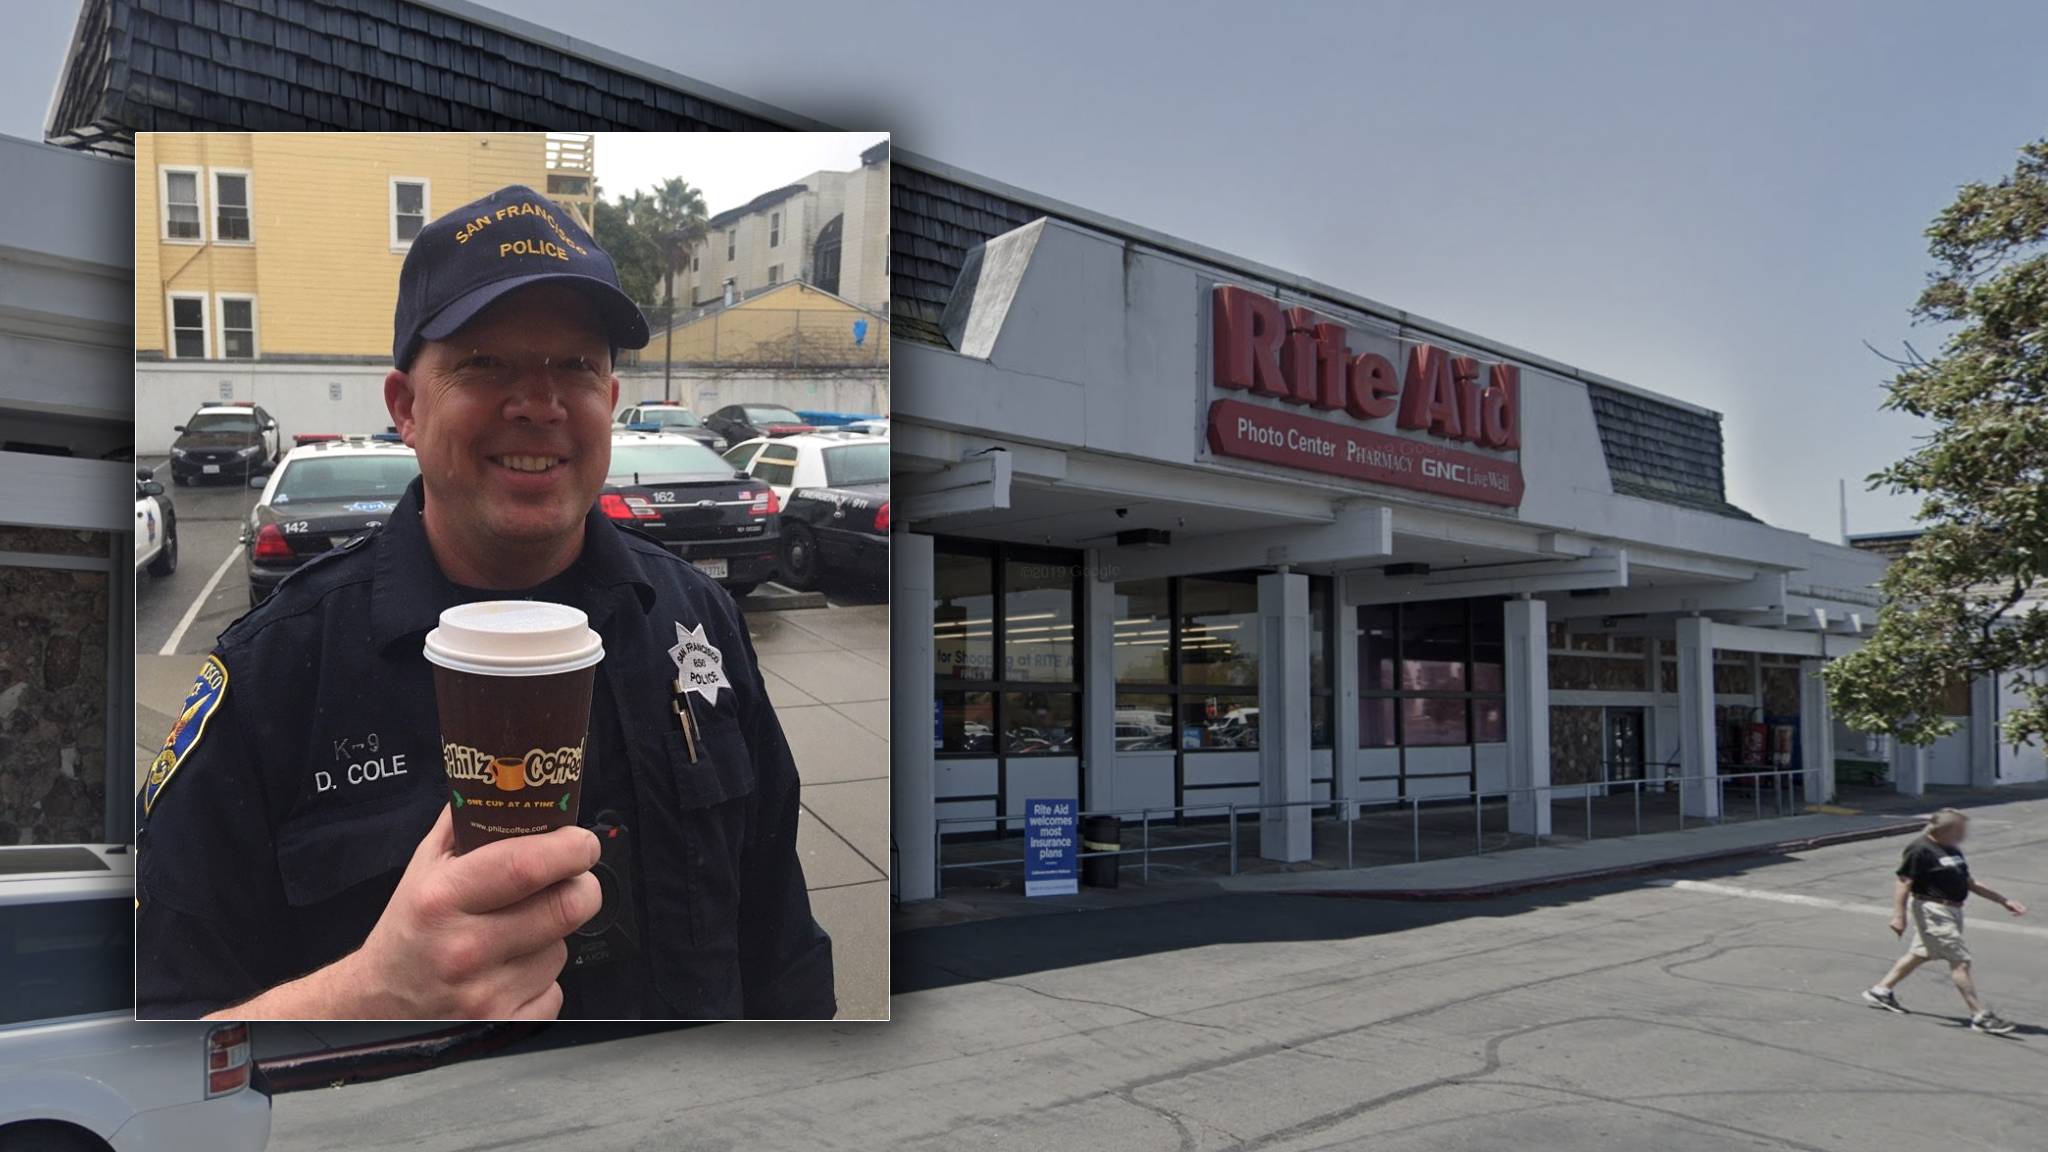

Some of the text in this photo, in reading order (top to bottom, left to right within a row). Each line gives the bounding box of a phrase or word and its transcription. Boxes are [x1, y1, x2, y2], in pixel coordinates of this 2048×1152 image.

[455, 202, 588, 256] SAN FRANCISCO
[500, 238, 569, 261] POLICE
[1212, 283, 1521, 451] Rite Aid
[1237, 417, 1284, 447] Photo
[1287, 428, 1336, 457] Center
[1346, 440, 1414, 472] PHARMACY
[1421, 458, 1465, 482] GNC
[653, 491, 675, 502] 162
[283, 521, 308, 533] 142
[690, 671, 719, 685] POLICE
[334, 733, 379, 760] K-9
[315, 754, 407, 792] D. COLE
[523, 747, 582, 787] Coffee
[466, 798, 483, 806] ONE
[486, 800, 504, 808] CUP
[1034, 804, 1069, 815] Rite Aid
[470, 821, 548, 834] www.philzcoffee.com
[1029, 816, 1072, 826] welcomes
[1040, 827, 1062, 837] most
[1040, 848, 1063, 861] plans
